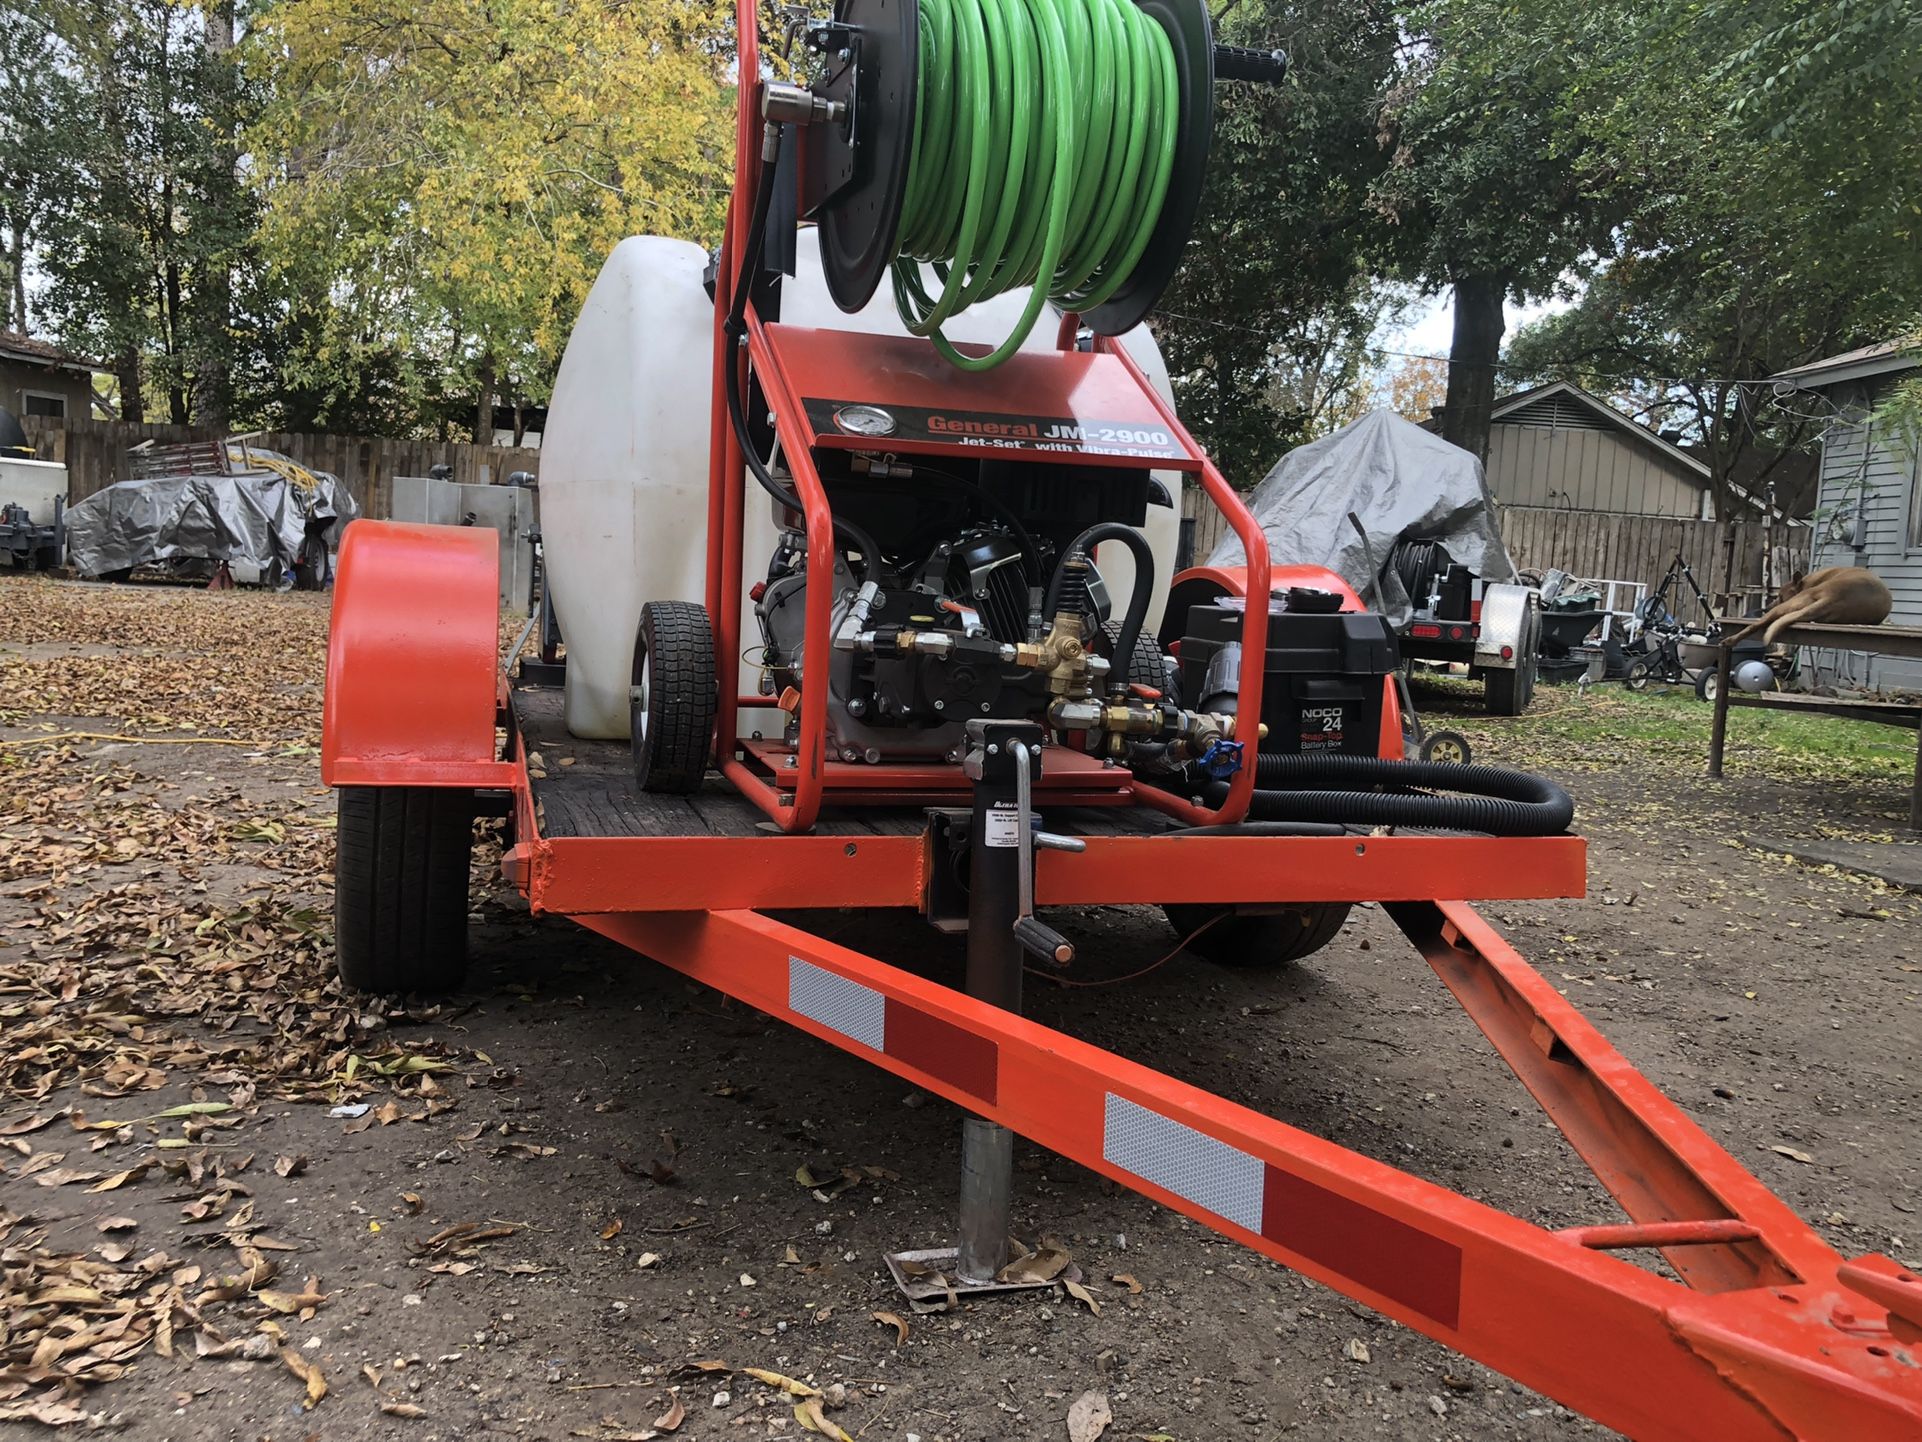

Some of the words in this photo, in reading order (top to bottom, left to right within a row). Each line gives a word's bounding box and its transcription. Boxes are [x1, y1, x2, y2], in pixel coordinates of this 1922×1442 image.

[928, 416, 1038, 437] General
[1044, 425, 1168, 446] JM-2900
[1035, 442, 1072, 452] with
[1302, 708, 1343, 719] NOCO
[1322, 717, 1343, 731] 24
[1301, 741, 1326, 750] Battery
[1328, 740, 1342, 748] Box
